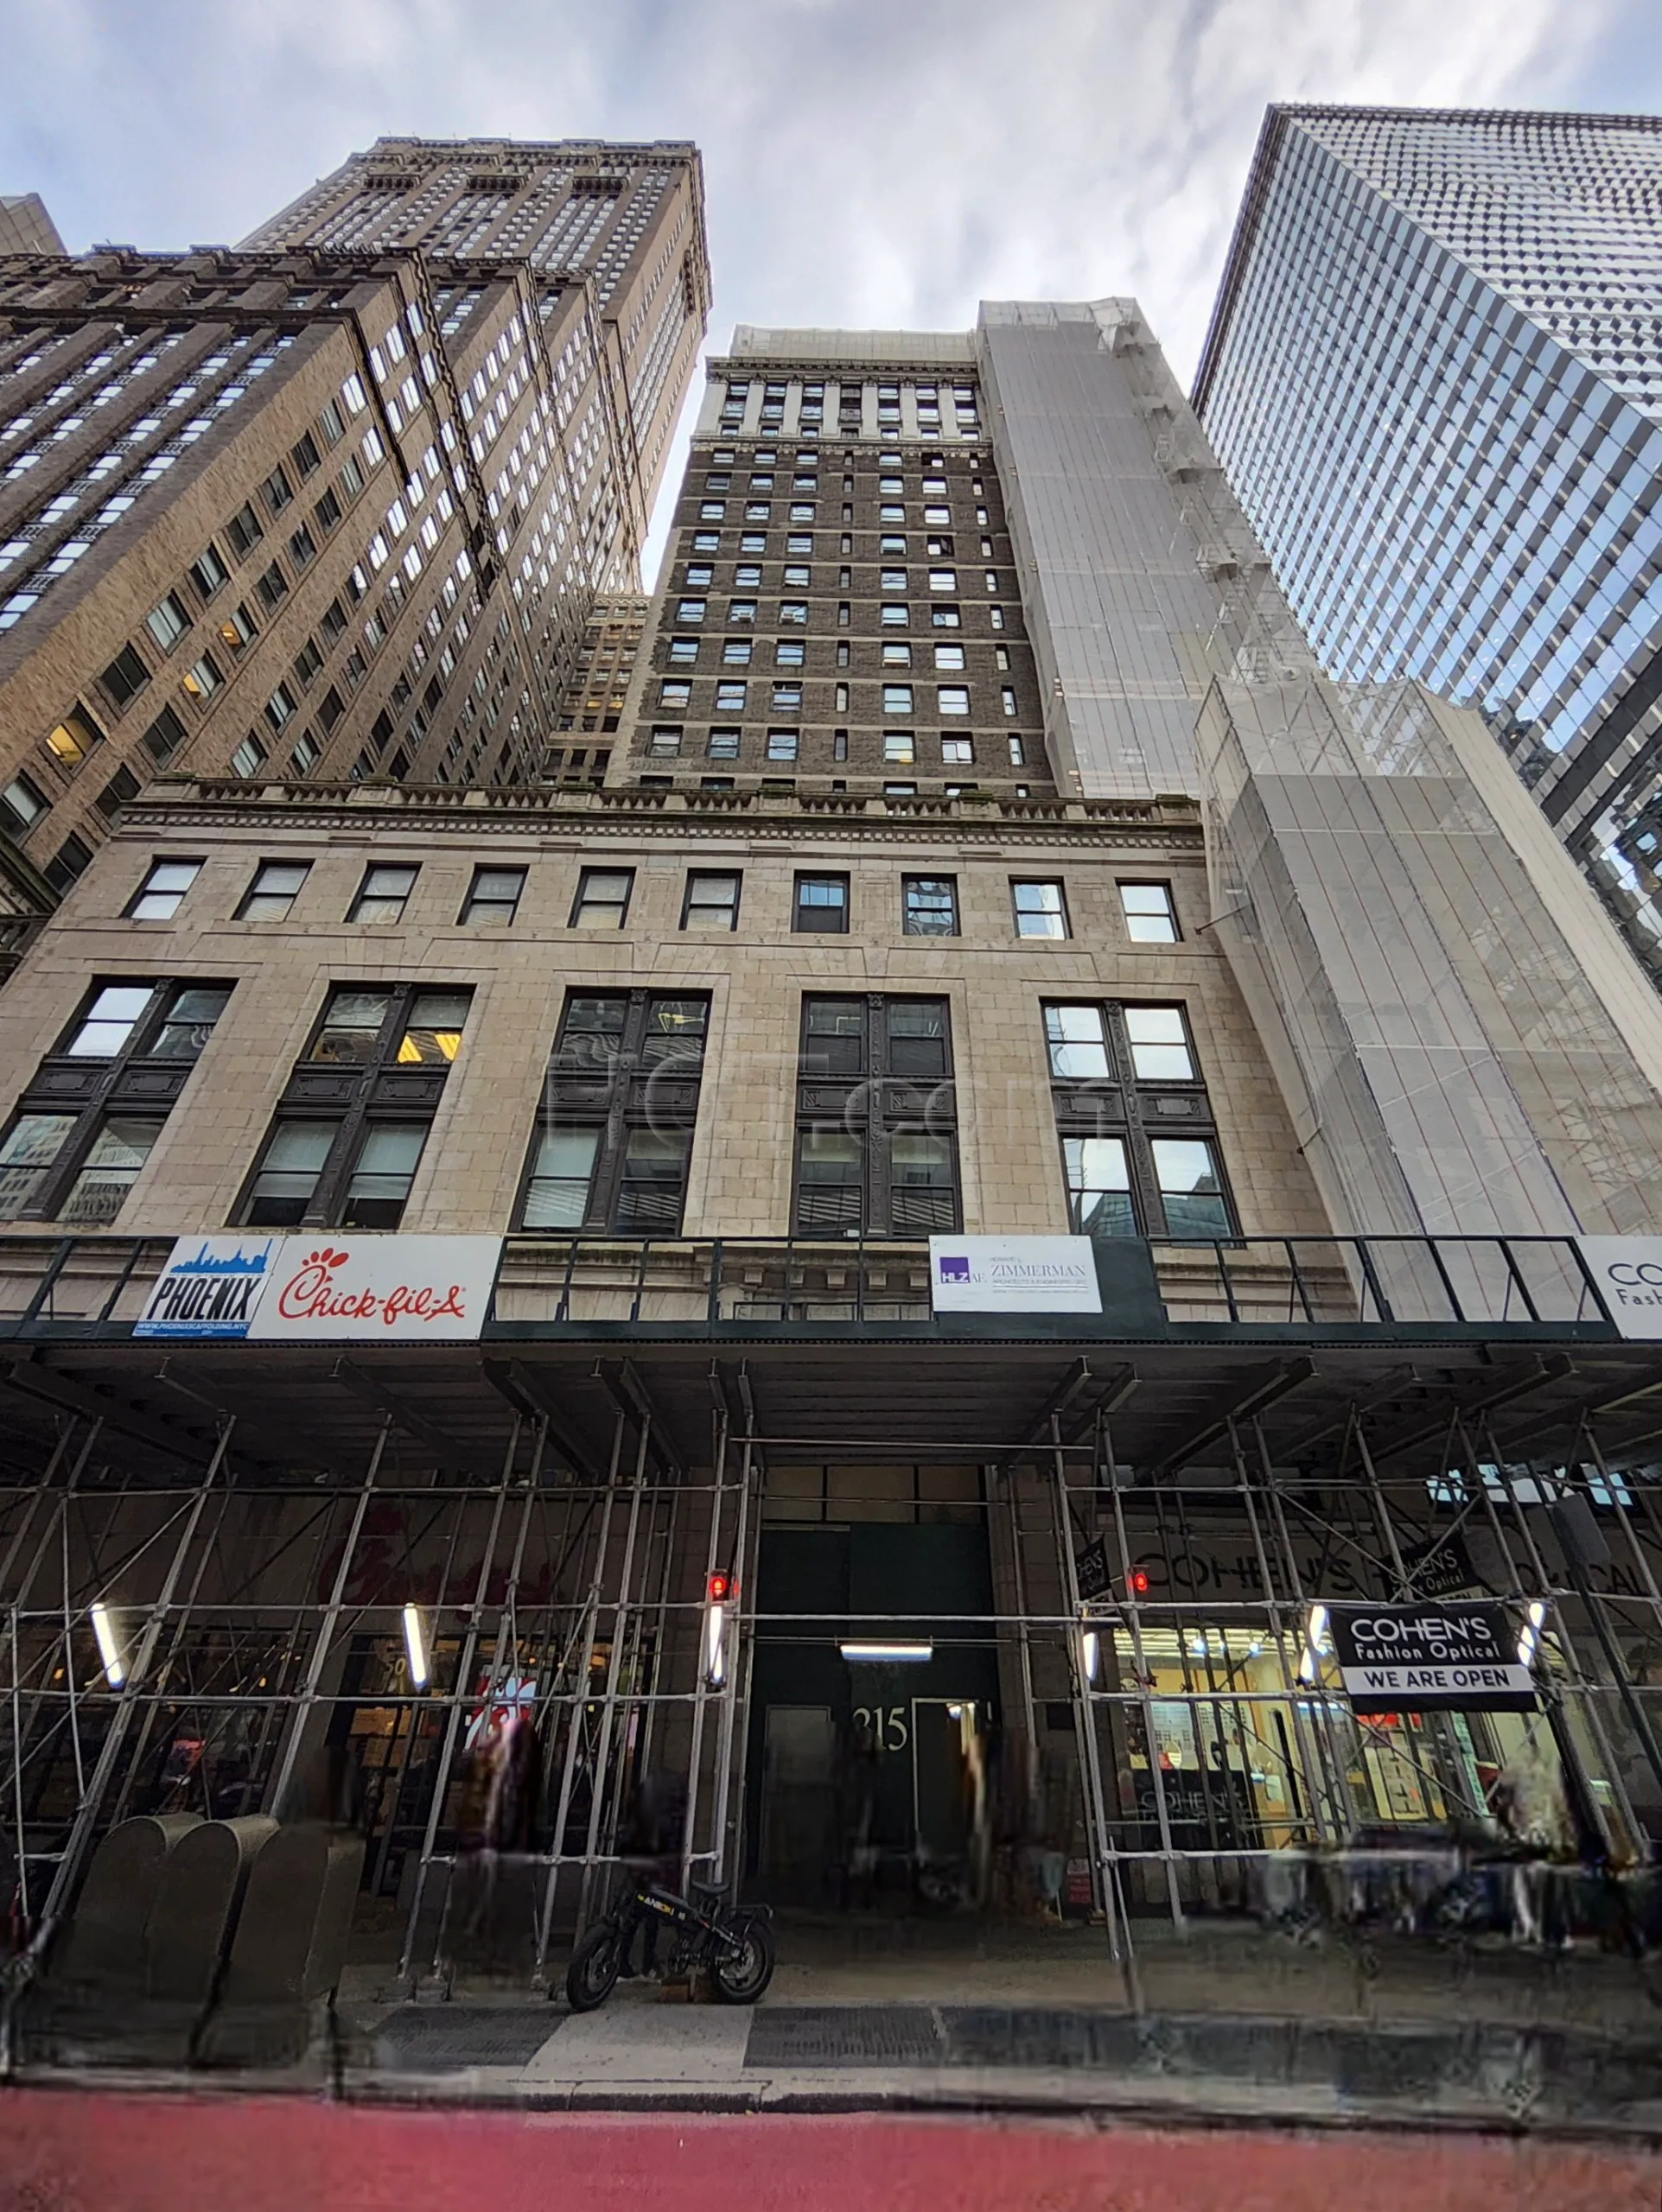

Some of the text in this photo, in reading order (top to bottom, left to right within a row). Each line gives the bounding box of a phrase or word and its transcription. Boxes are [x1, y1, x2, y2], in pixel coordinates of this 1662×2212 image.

[942, 1272, 969, 1283] HLZ
[990, 1264, 1086, 1276] ZIMMERMAN
[146, 1277, 261, 1320] PHOENIX
[278, 1264, 466, 1325] Chick-fil-A
[1351, 1617, 1491, 1642] COHEN'S
[1354, 1641, 1500, 1662] Fashion Optical
[1364, 1669, 1511, 1688] WE ARE OPEN
